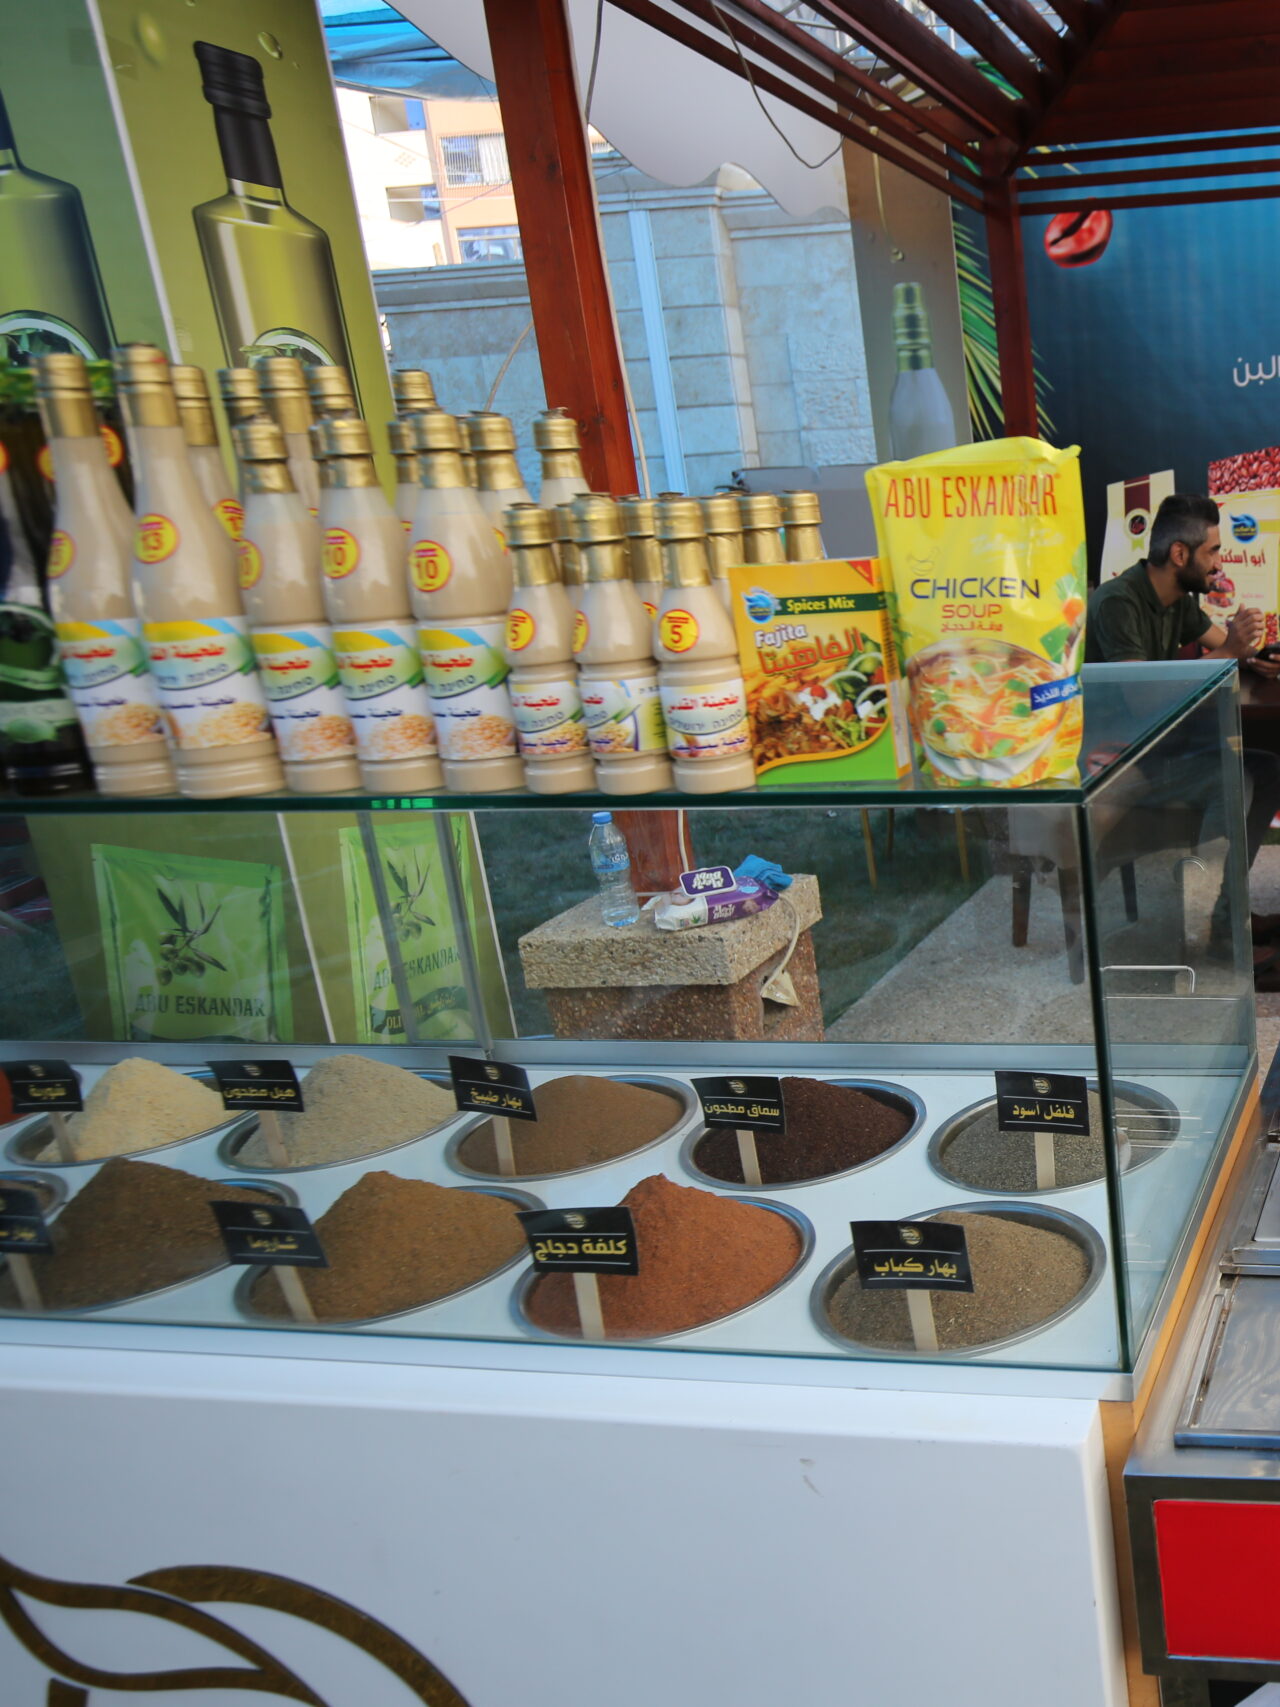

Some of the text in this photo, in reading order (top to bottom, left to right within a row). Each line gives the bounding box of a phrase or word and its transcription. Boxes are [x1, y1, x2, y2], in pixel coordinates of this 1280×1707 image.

[884, 477, 931, 519] ABU
[415, 558, 438, 579] 10
[910, 577, 1041, 599] CHICKEN
[786, 599, 827, 614] Spices
[828, 597, 856, 610] Mix
[941, 603, 1004, 619] SOUP
[510, 623, 520, 642] 5
[669, 624, 683, 644] 5
[754, 624, 807, 649] Fajita
[175, 995, 266, 1016] ESKANDAR
[704, 1103, 780, 1117] سماق مطحون
[1012, 1101, 1075, 1120] فلفل أسود
[535, 1238, 627, 1261] كلفة دجاج
[873, 1257, 958, 1278] بهار كباب
